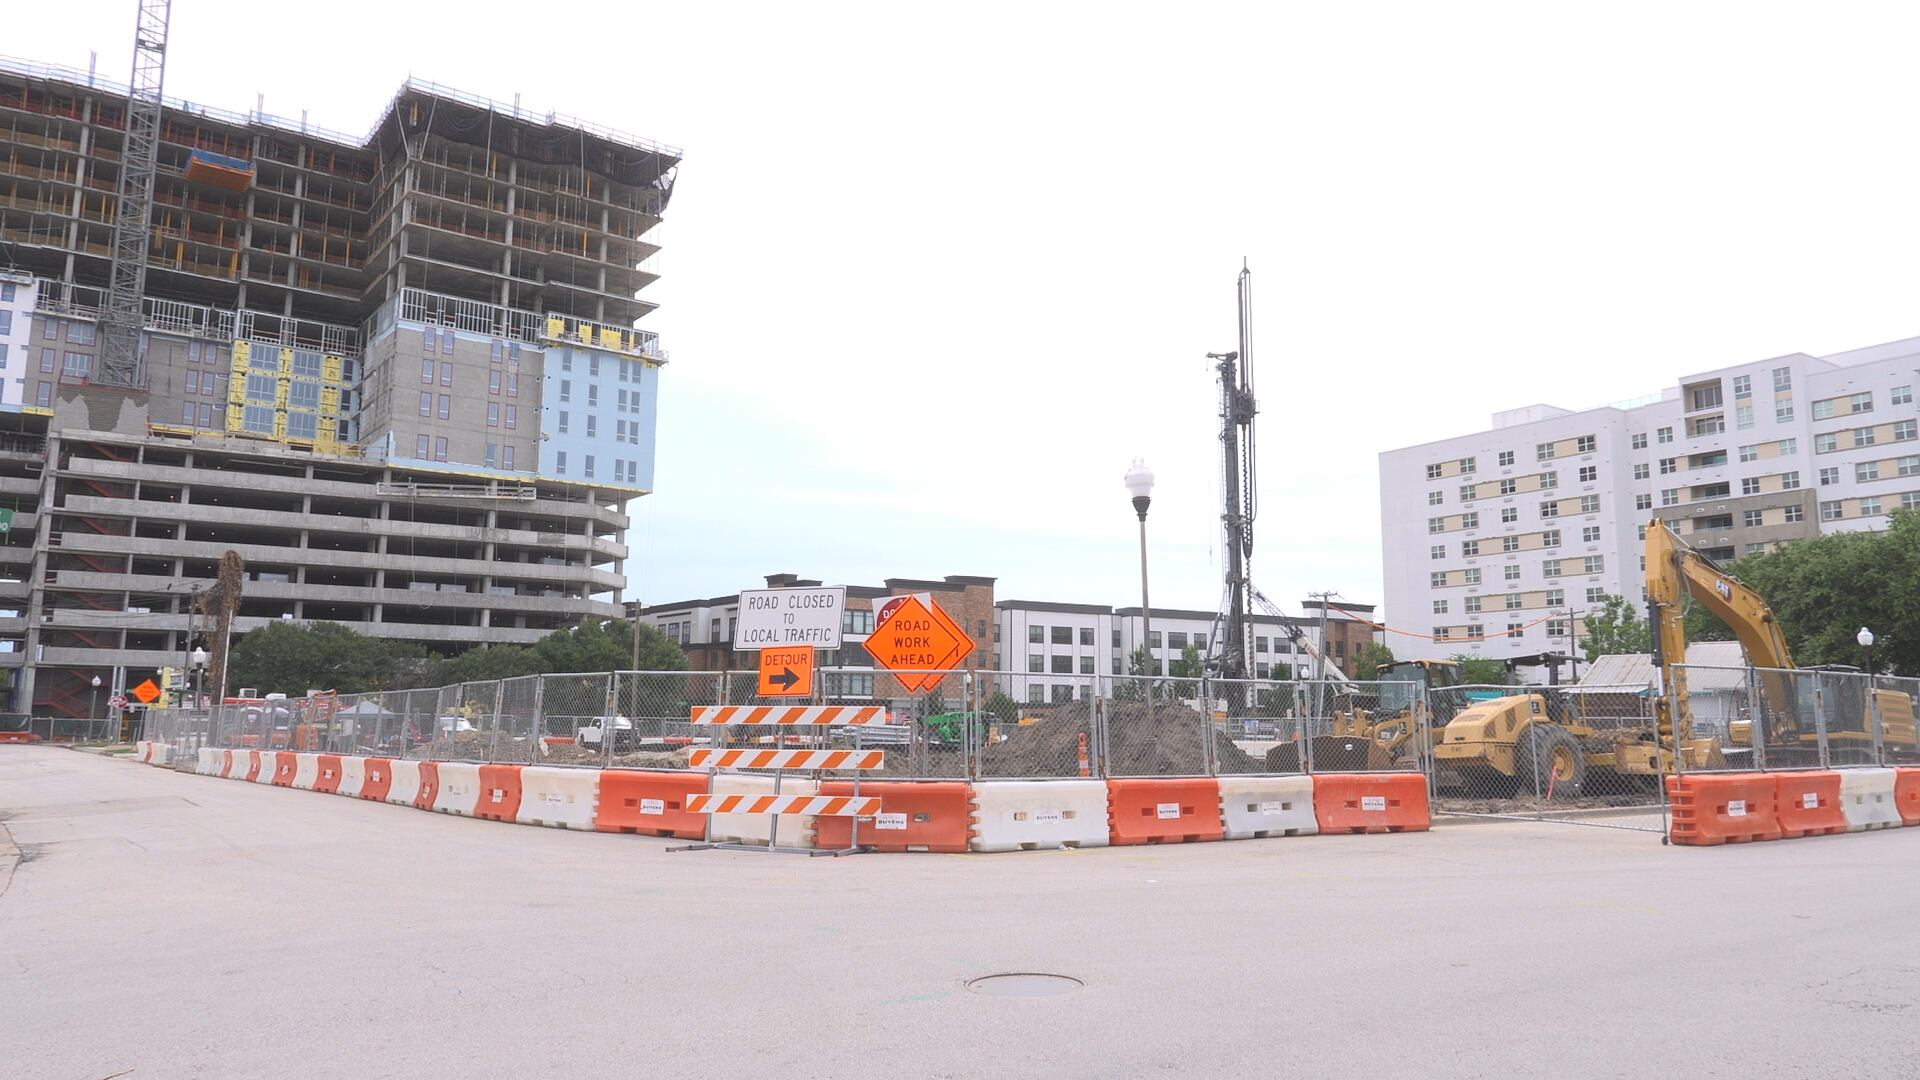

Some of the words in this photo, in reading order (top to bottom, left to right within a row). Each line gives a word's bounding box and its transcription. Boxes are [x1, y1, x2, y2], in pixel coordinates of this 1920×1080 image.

[749, 596, 778, 610] ROAD
[789, 595, 834, 608] CLOSED
[784, 613, 794, 624] TO
[895, 620, 930, 631] ROAD
[744, 629, 779, 642] LOCAL
[784, 628, 831, 642] TRAFFIC
[894, 637, 930, 648] WORK
[765, 653, 808, 666] DETOUR
[891, 654, 935, 665] AHEAD
